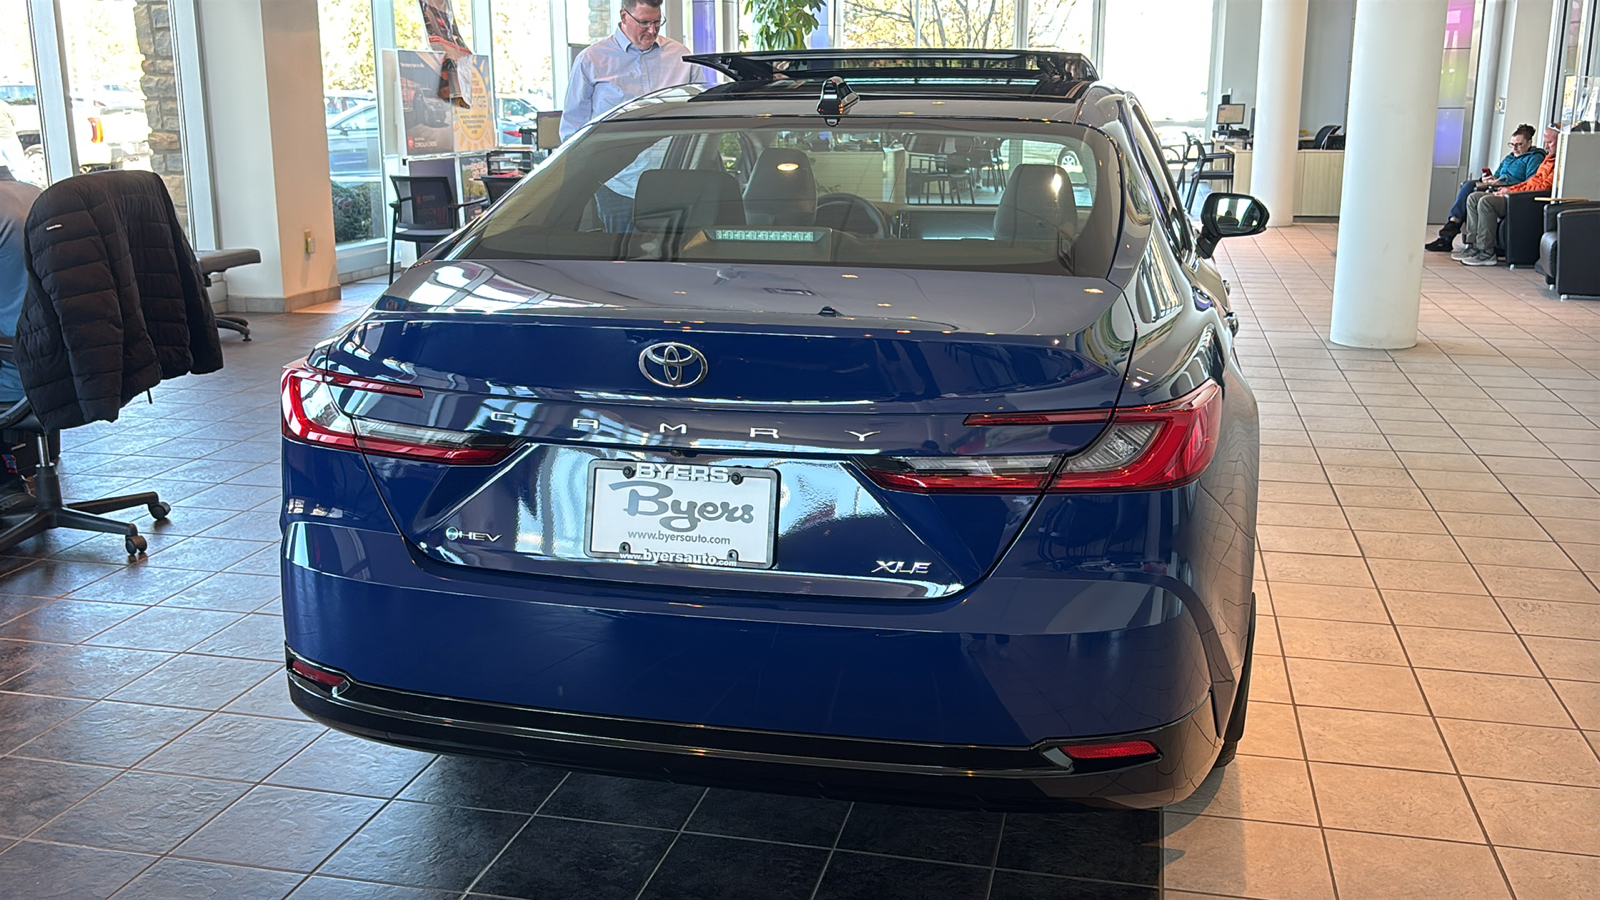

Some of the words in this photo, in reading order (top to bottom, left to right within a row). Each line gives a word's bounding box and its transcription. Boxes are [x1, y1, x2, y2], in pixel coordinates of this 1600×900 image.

[490, 410, 881, 442] CAMRY
[635, 462, 729, 483] BYERS
[608, 480, 754, 533] Byers
[628, 530, 731, 545] www.byersauto.com
[619, 548, 737, 567] www.byersauto.com
[870, 560, 932, 575] XLE
